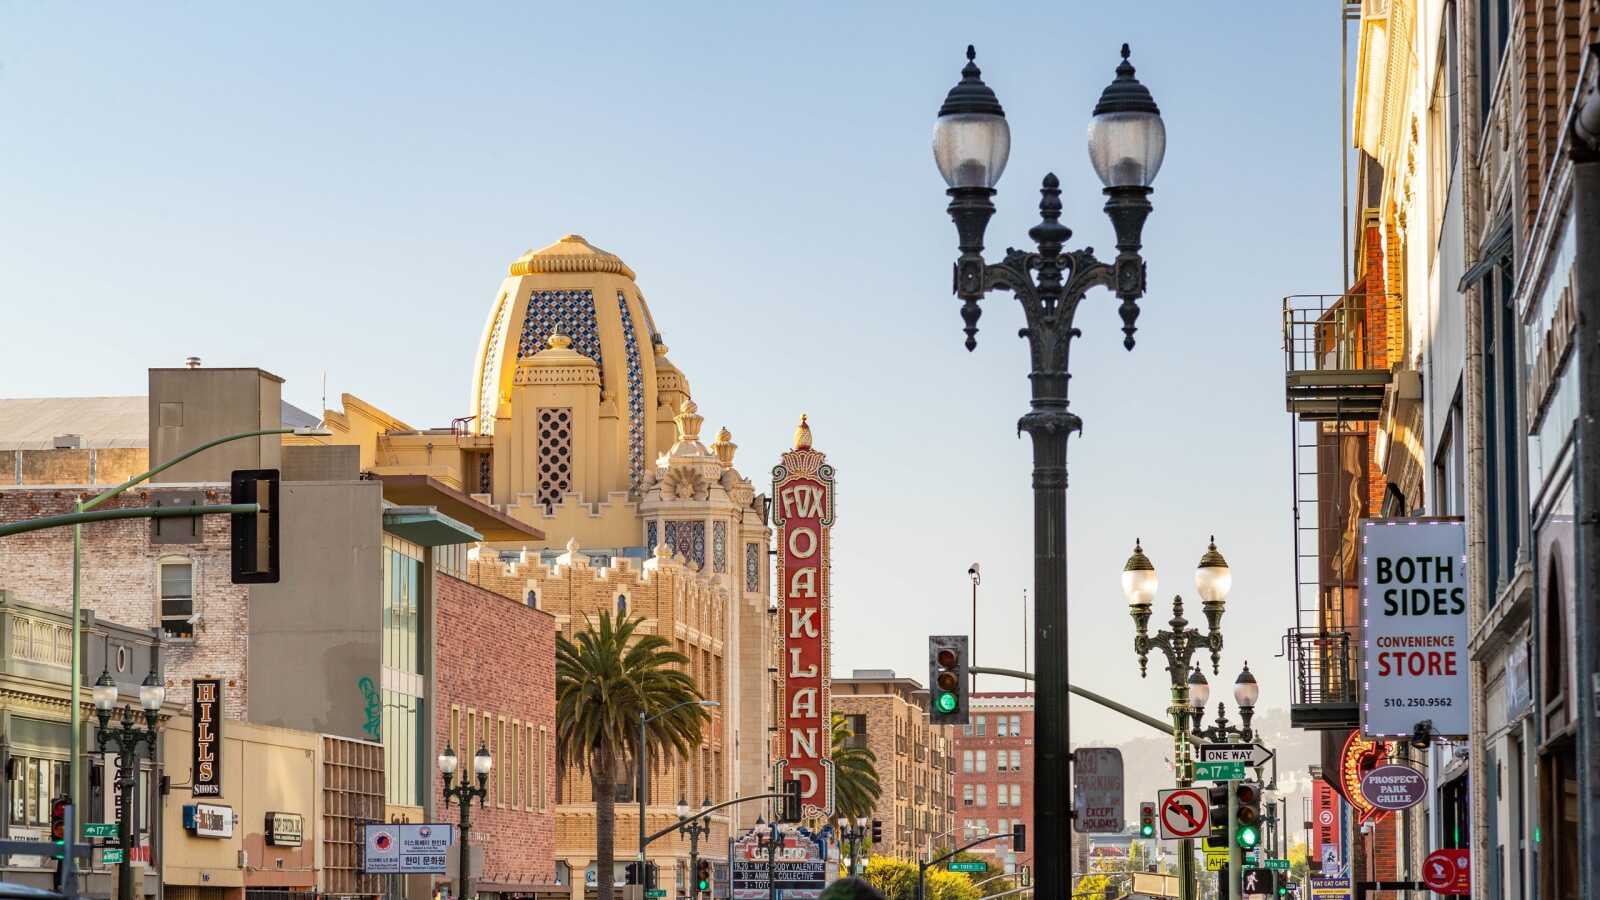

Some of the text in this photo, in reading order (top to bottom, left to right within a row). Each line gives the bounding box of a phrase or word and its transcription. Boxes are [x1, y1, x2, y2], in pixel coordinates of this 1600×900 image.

[781, 484, 825, 518] FOX
[1376, 556, 1453, 584] BOTH
[1384, 587, 1465, 616] SIDES
[1376, 636, 1455, 648] CONVENIENCE
[788, 527, 819, 799] OAKLAND
[1378, 651, 1457, 677] STORE
[1407, 698, 1452, 707] 250.9562
[197, 683, 216, 782] HILLS
[1208, 751, 1252, 760] ONE WAY
[1368, 775, 1419, 784] PROSPECT
[193, 784, 219, 794] SHOES
[1380, 785, 1408, 794] PARK
[1376, 794, 1412, 803] GRILLE
[1086, 808, 1114, 816] EXCEPT
[1083, 819, 1119, 830] HOLIDAYS
